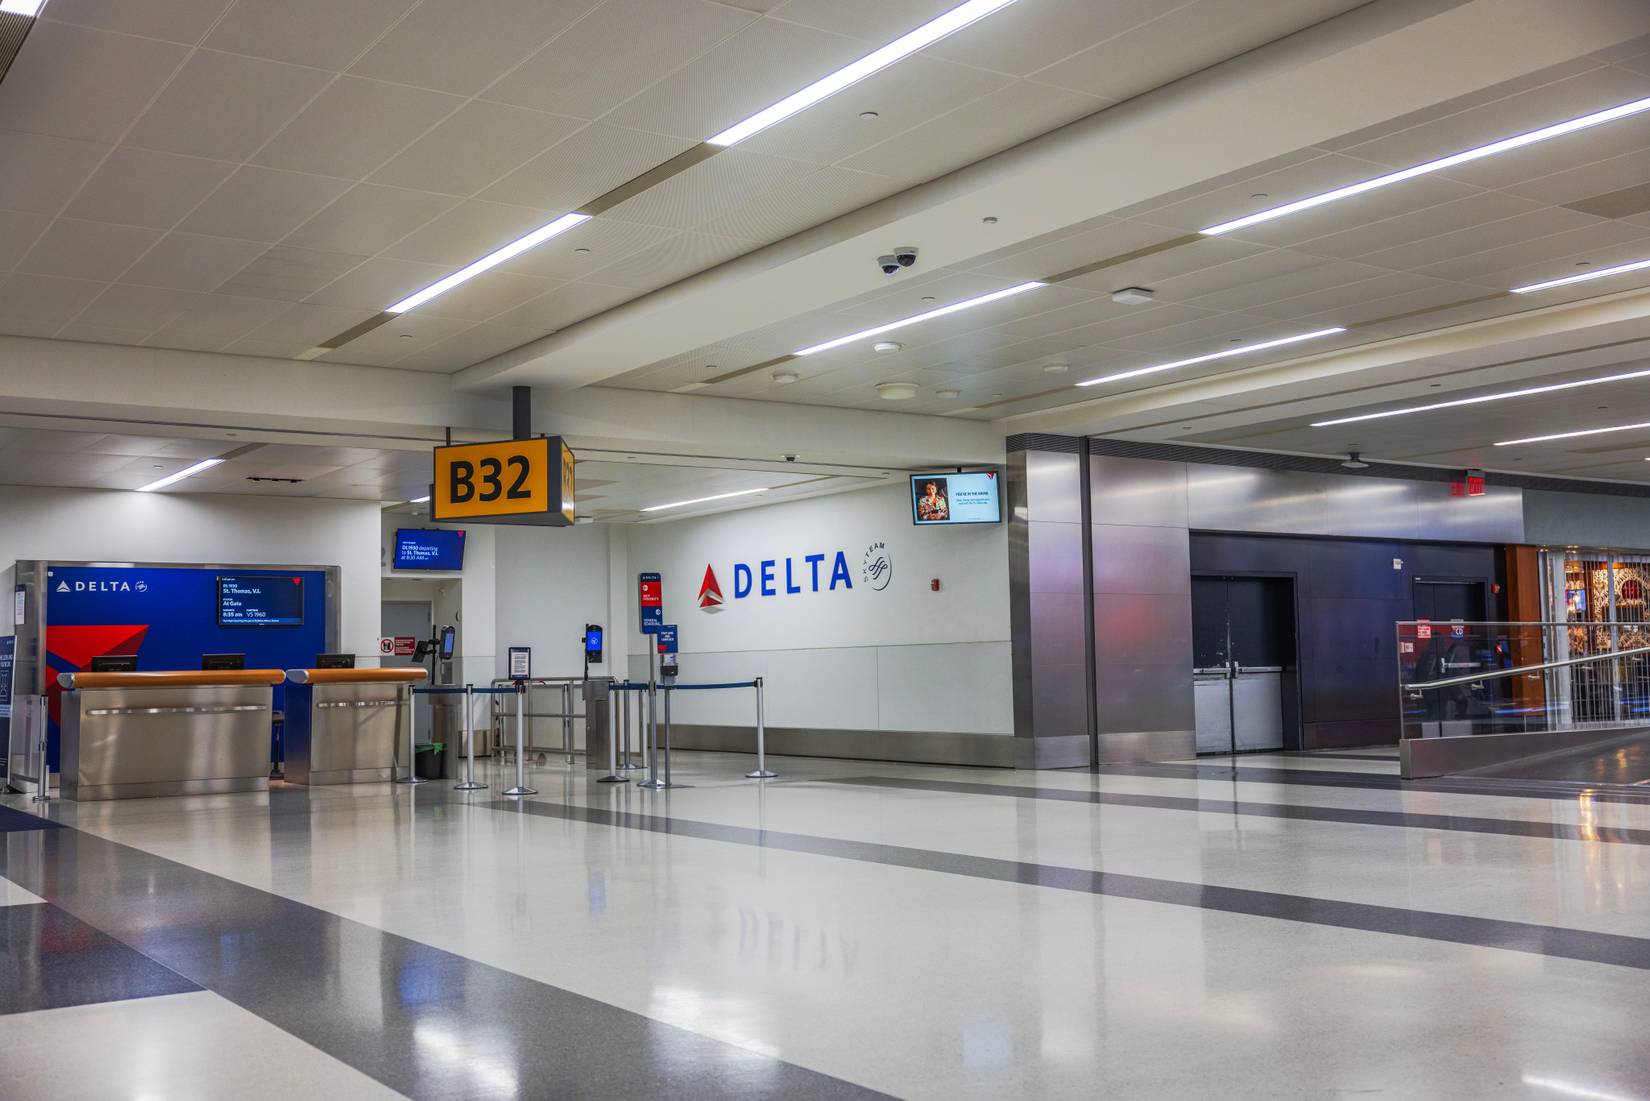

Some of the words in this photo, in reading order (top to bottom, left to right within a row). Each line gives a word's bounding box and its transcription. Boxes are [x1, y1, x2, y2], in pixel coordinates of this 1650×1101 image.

[450, 455, 531, 504] B32
[75, 581, 131, 592] DELTA
[734, 551, 853, 599] DELTA
